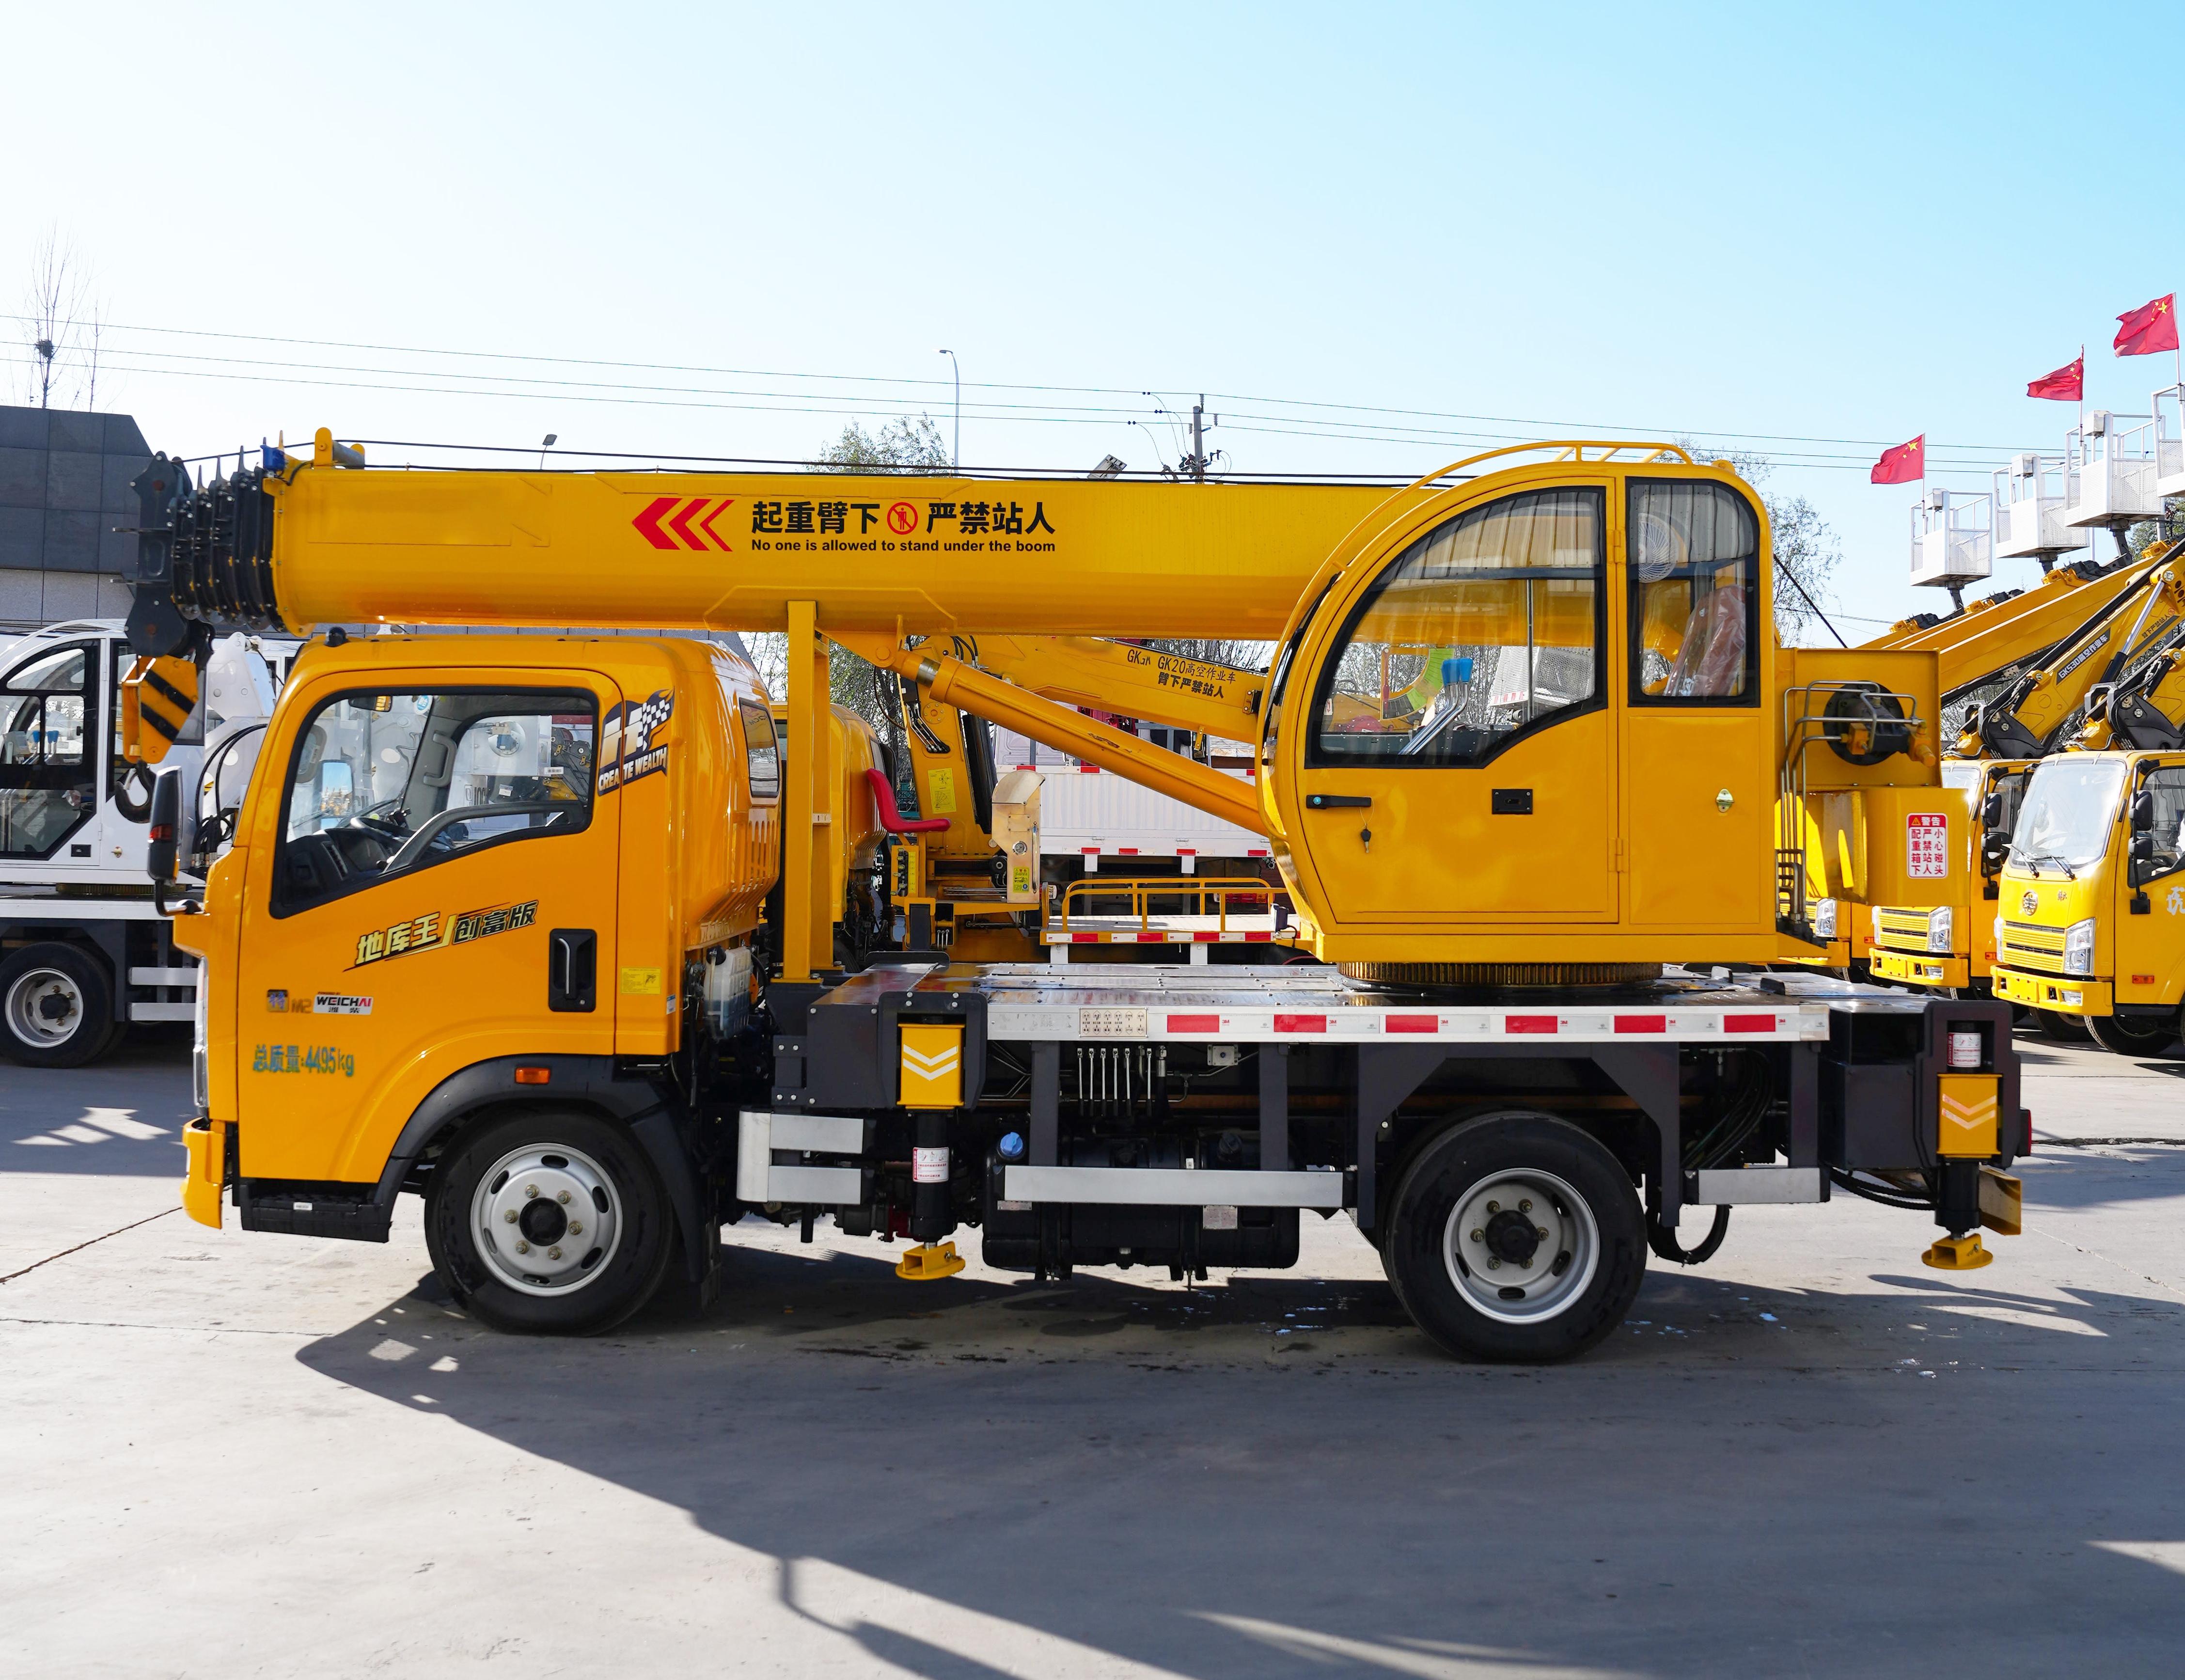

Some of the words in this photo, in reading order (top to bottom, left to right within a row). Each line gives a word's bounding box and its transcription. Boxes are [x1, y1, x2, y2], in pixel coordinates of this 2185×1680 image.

[752, 501, 880, 534] 起重臂下
[927, 502, 1055, 534] 严禁站人
[752, 539, 770, 550] No
[775, 542, 801, 550] one
[806, 539, 817, 550] is
[822, 539, 877, 551] allowed
[881, 540, 895, 551] to
[900, 540, 939, 551] stand
[944, 540, 985, 551] under
[989, 540, 1011, 551] the
[1016, 540, 1055, 551] boom
[1158, 672, 1225, 699] 臂下严禁站人
[598, 763, 634, 791] CREATE
[634, 747, 667, 775] WEALTH
[1921, 816, 1941, 826] 警告
[1911, 829, 1921, 875] 配重箱下
[1922, 829, 1933, 875] 严禁站人
[1934, 829, 1944, 875] 小心碰头
[354, 911, 441, 966] 地库王
[452, 899, 539, 945] 创富版
[316, 996, 372, 1007] WEICHAI
